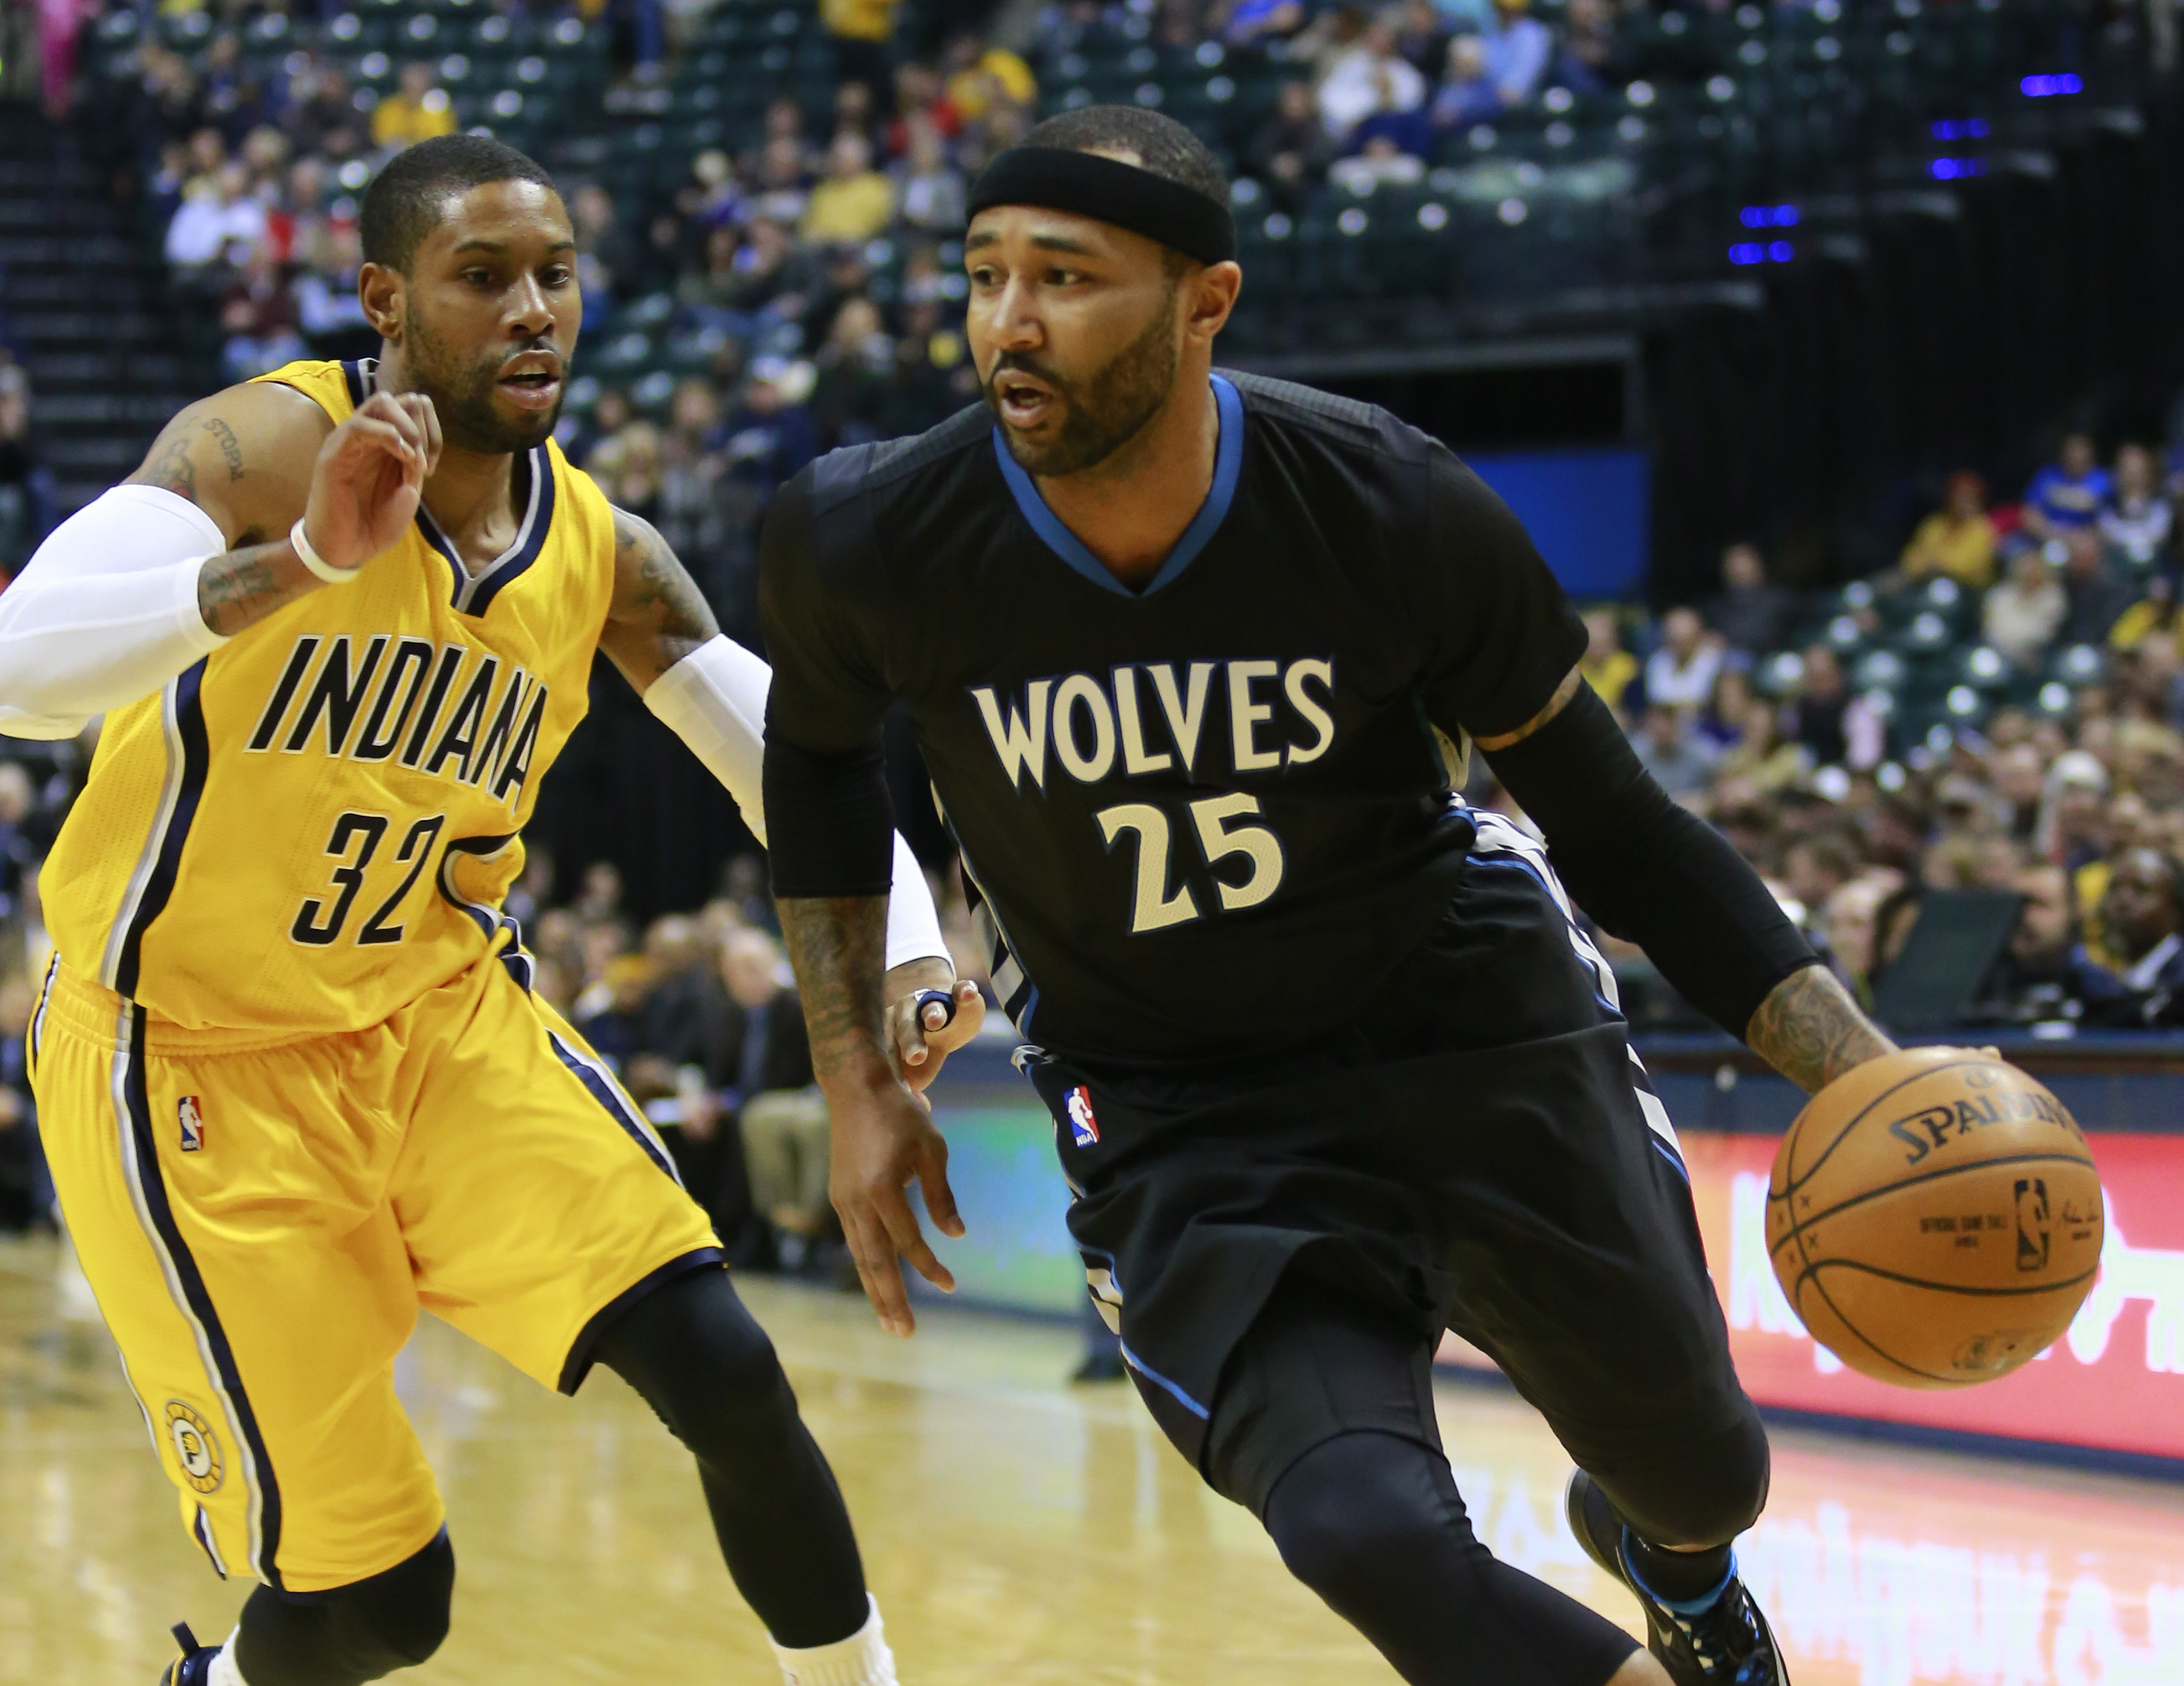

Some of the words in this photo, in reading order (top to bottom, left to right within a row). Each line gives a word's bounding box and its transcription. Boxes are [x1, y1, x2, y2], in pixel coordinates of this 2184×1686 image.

[243, 633, 548, 815] INDIANA
[968, 655, 1335, 796] WOLVES
[289, 811, 446, 947] 32
[1094, 792, 1286, 936] 25
[1076, 1132, 1093, 1146] NBA
